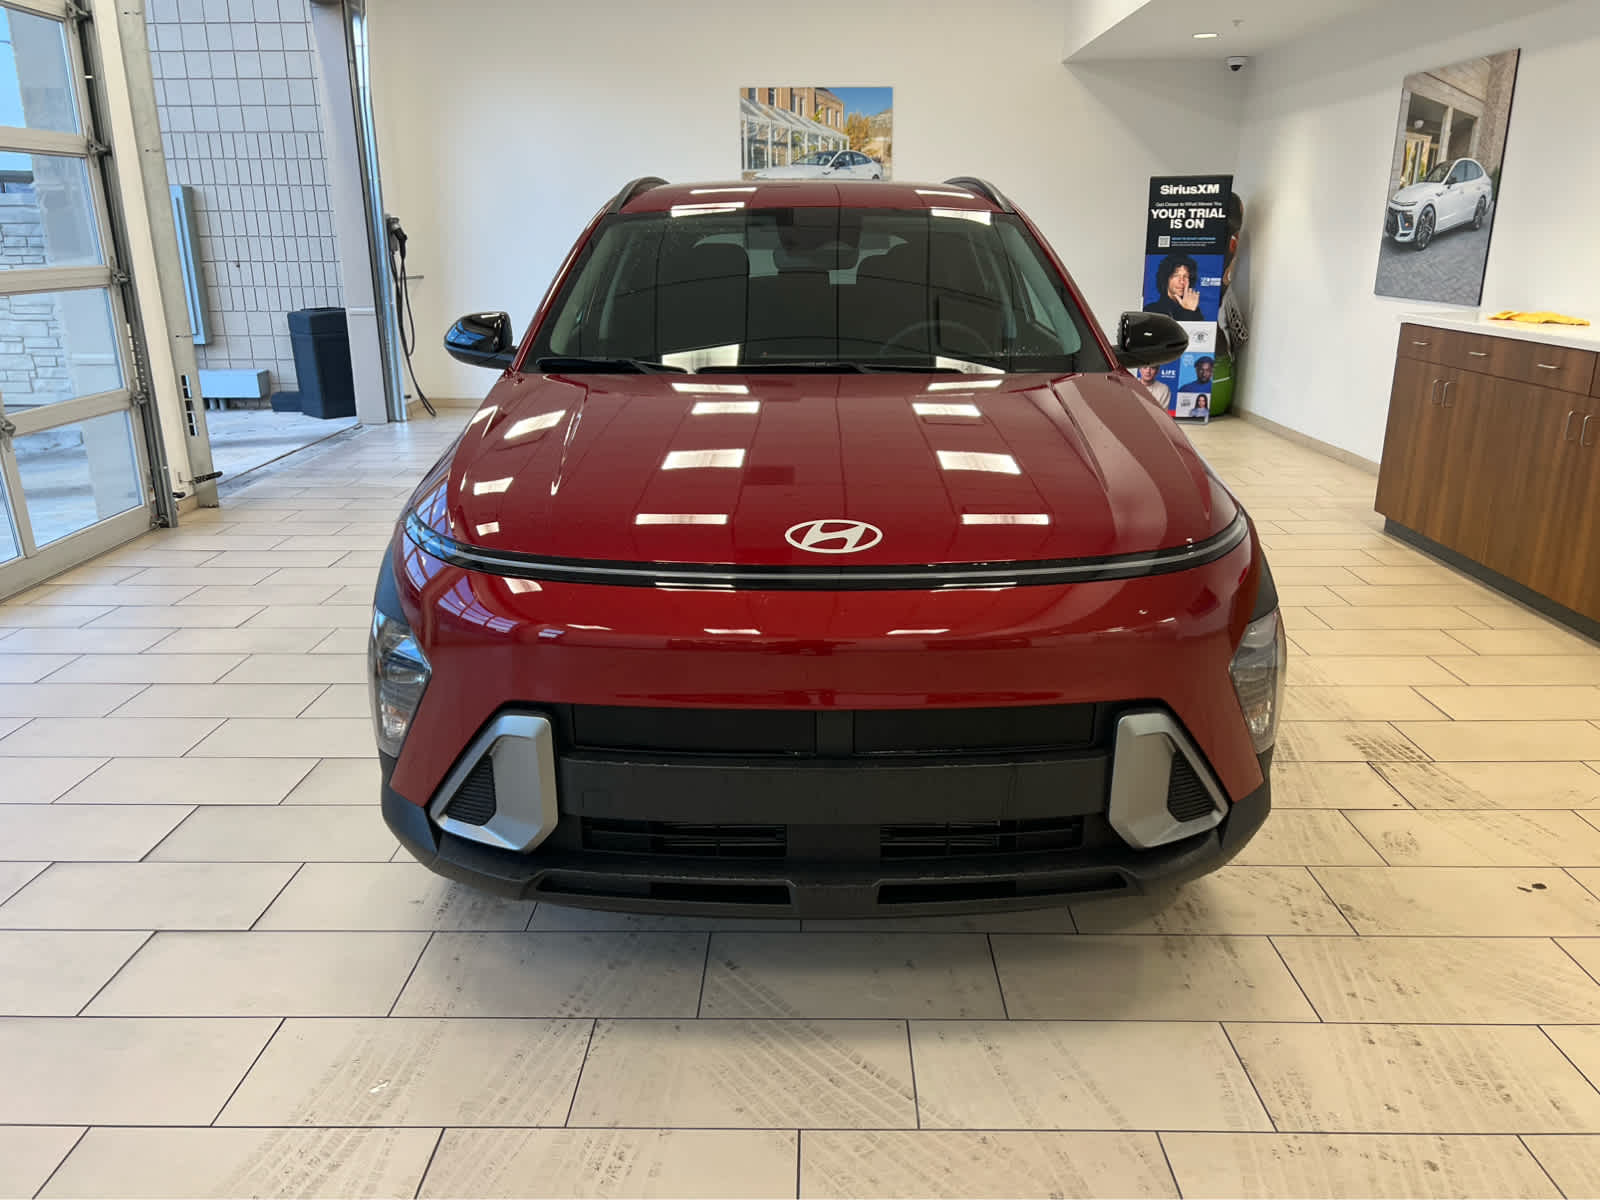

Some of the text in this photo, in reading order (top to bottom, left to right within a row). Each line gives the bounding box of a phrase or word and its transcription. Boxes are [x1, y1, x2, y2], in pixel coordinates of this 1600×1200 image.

[1160, 184, 1220, 195] SiriusXM
[1151, 207, 1227, 219] YOUR TRIAL
[1170, 218, 1205, 229] IS ON
